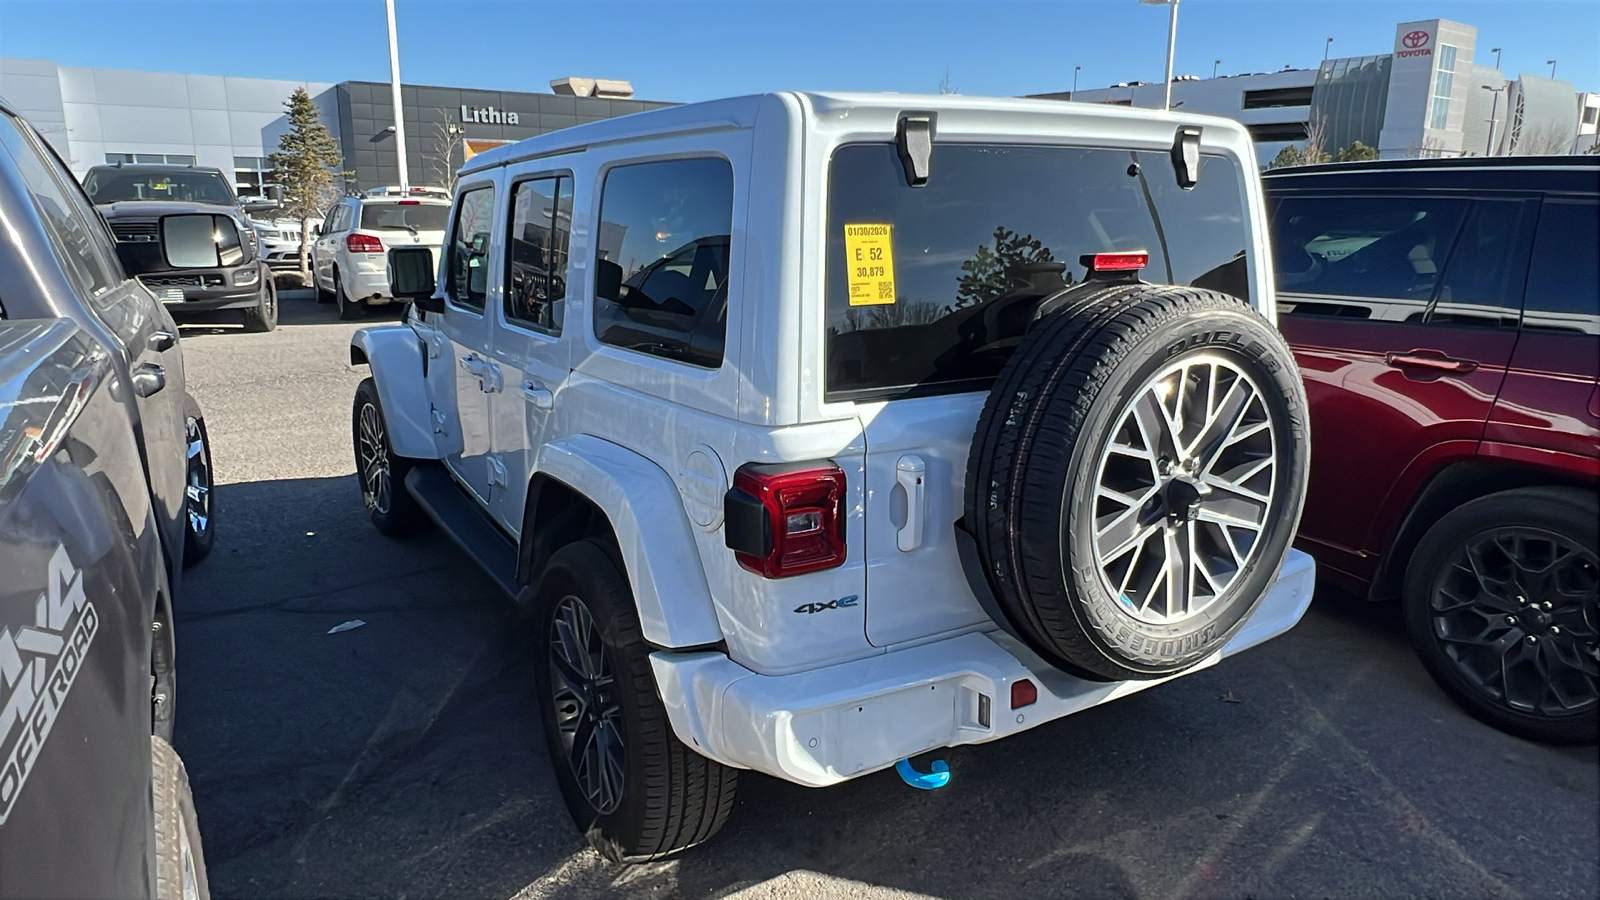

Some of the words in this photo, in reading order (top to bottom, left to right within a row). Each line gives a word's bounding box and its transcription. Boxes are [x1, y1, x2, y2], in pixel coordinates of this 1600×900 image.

[1396, 49, 1432, 58] TOYOTA
[461, 104, 519, 125] Lithia
[847, 226, 888, 237] 01/30/2026
[855, 247, 863, 261] E
[869, 247, 883, 261] 52
[856, 266, 885, 278] 30,879
[1166, 331, 1282, 374] DUELER
[1080, 565, 1218, 657] BRIDGESTONE
